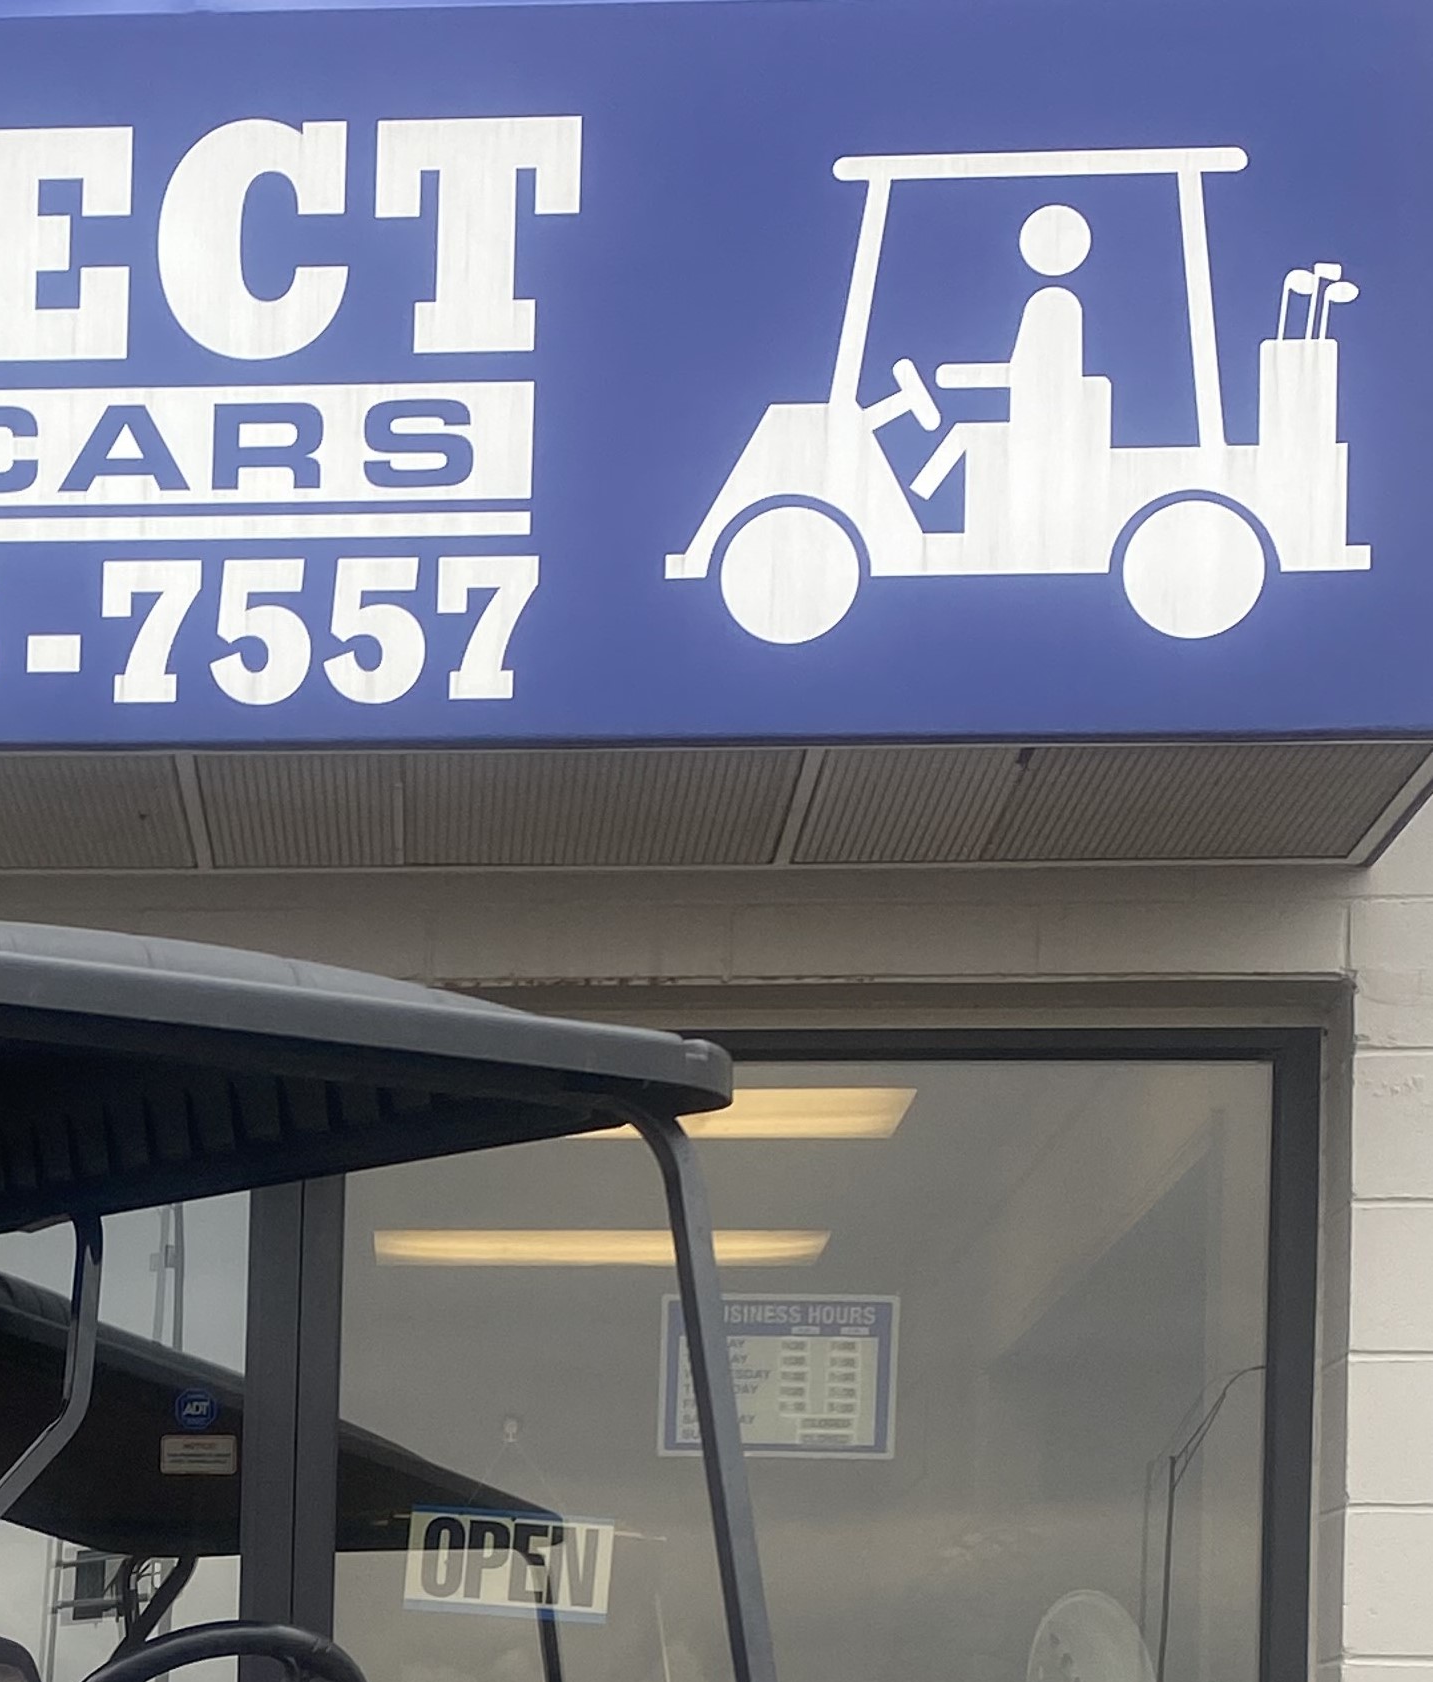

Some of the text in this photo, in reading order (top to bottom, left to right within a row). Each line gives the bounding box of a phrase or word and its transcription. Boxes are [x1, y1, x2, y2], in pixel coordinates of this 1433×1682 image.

[723, 1304, 877, 1325] SINESS HOURS
[183, 1401, 210, 1416] ADT
[420, 1515, 600, 1608] OPEN
